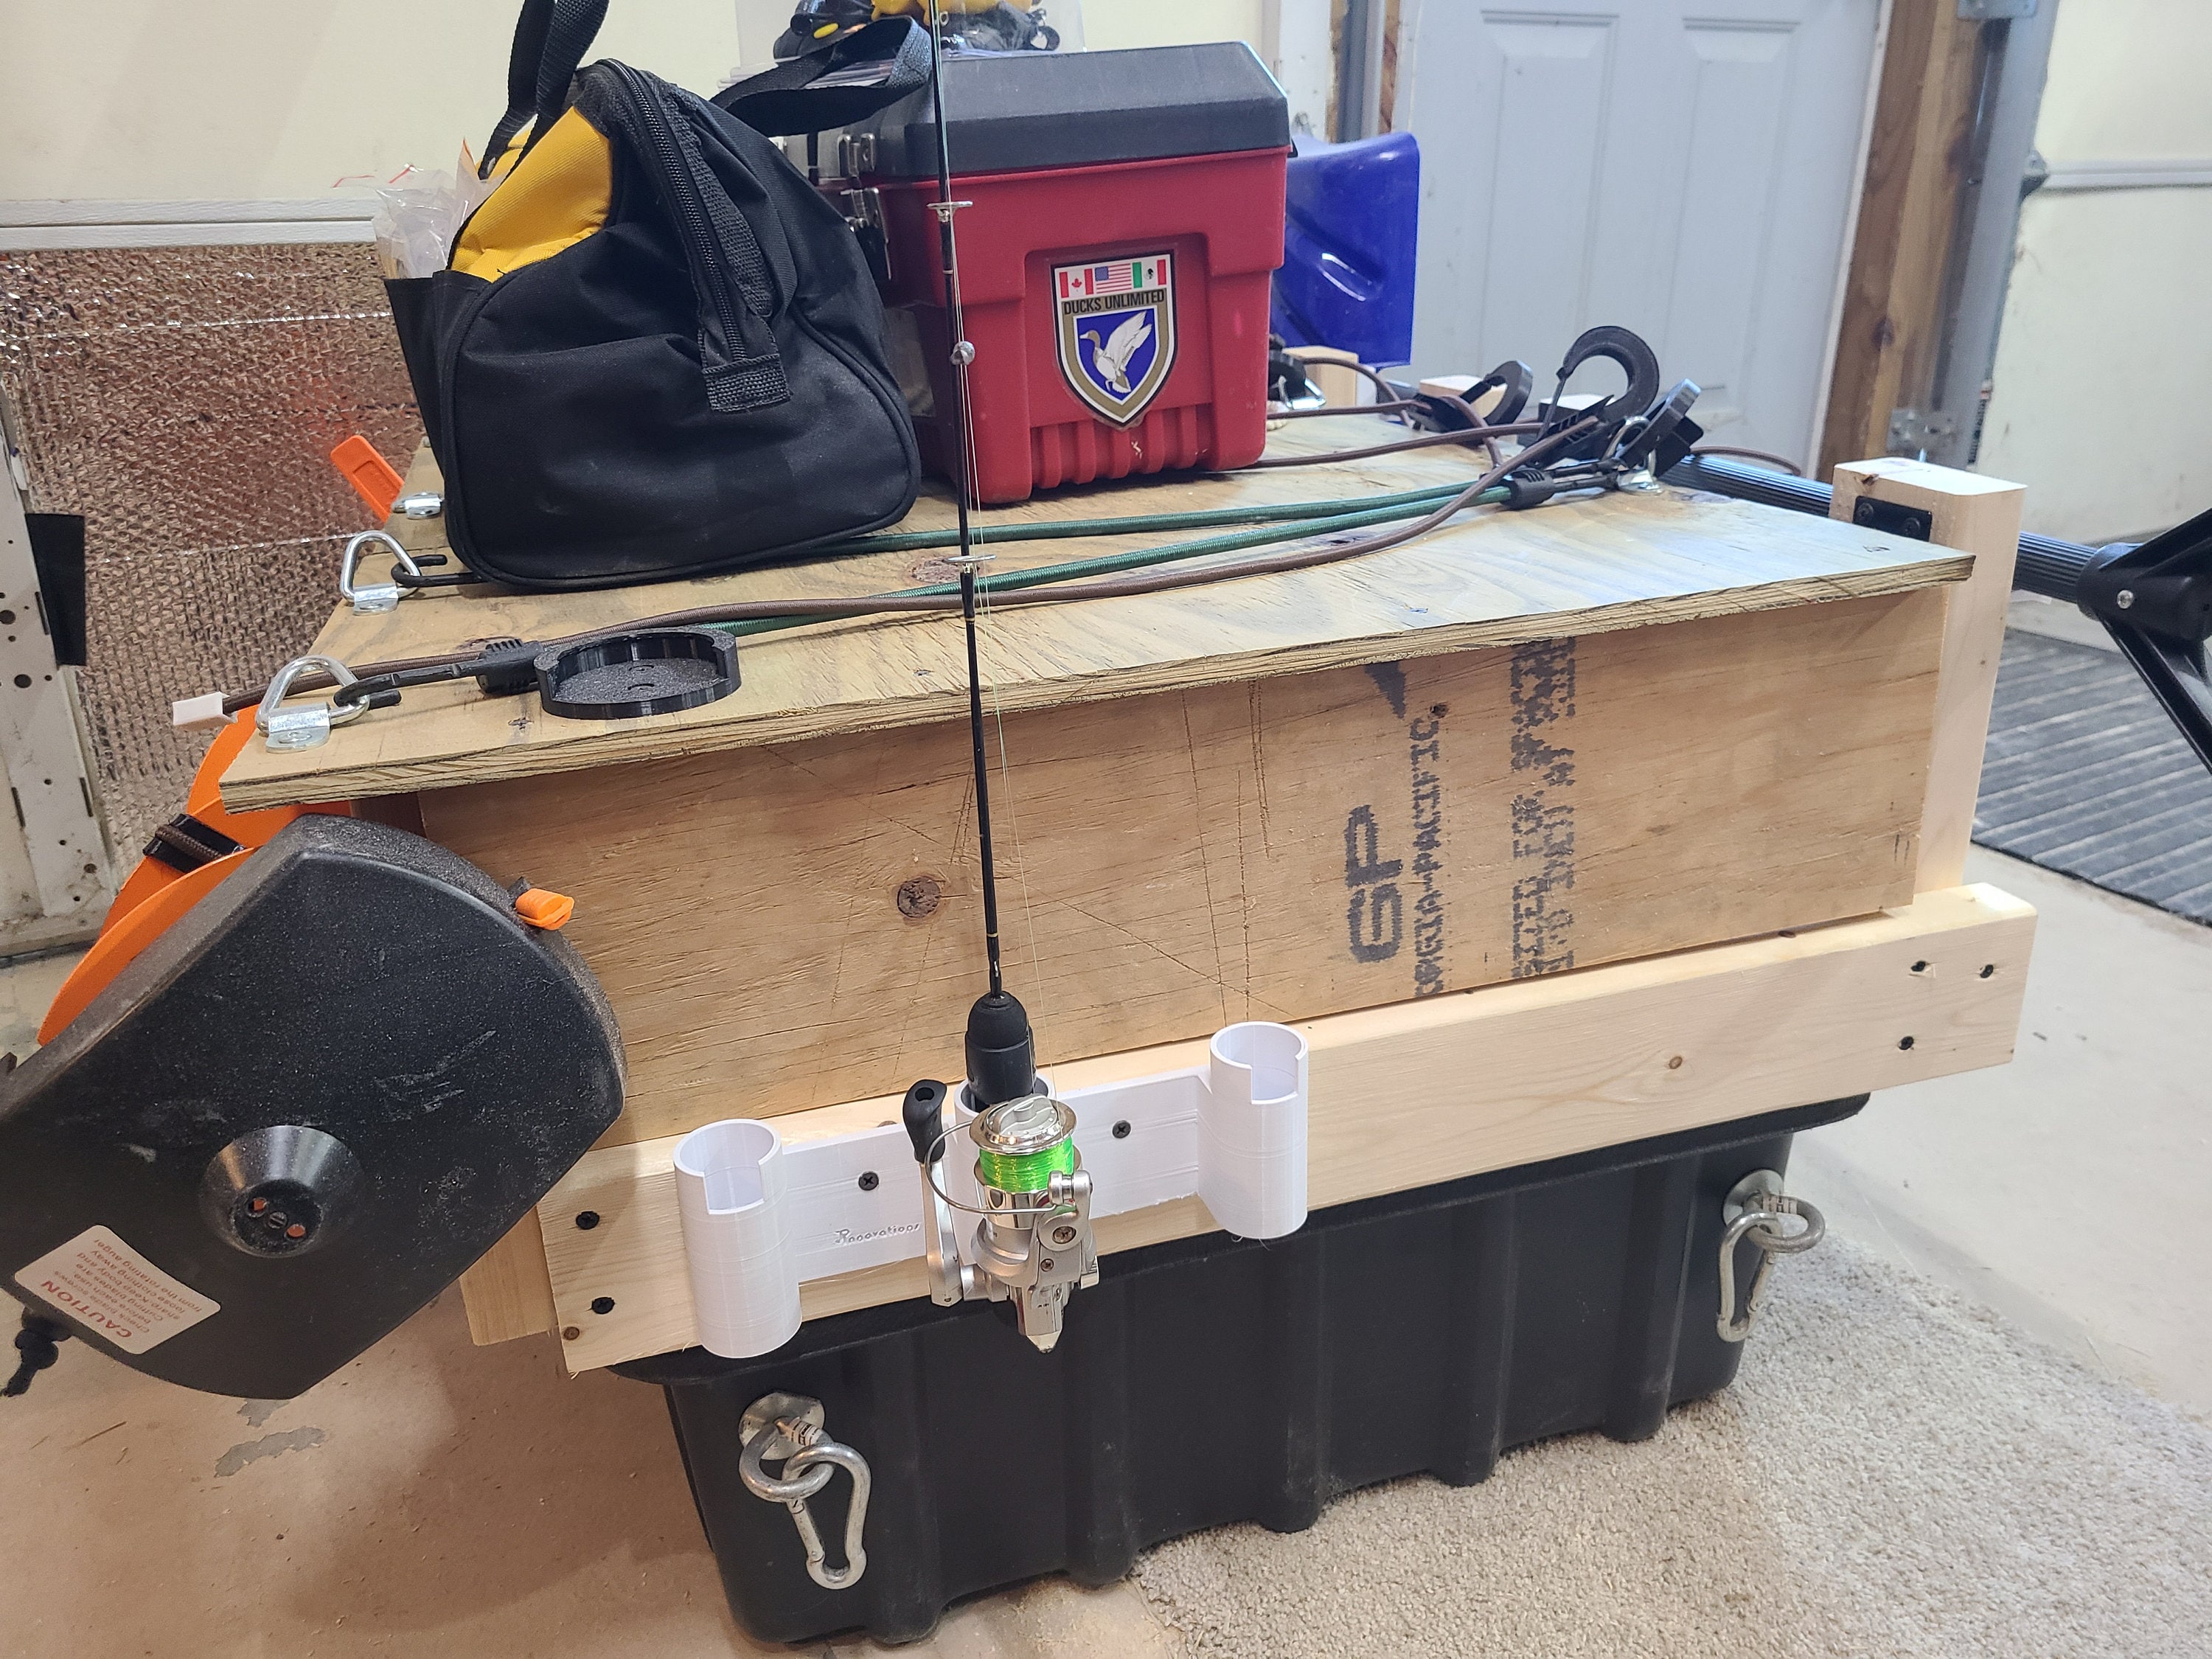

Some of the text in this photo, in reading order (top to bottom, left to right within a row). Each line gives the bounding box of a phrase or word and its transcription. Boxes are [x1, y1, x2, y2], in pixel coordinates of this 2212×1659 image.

[1064, 291, 1165, 315] DUCKS UNLIMITED
[1345, 804, 1402, 963] GP
[75, 1264, 93, 1275] are
[76, 1252, 97, 1266] and
[91, 1251, 117, 1269] away
[94, 1239, 201, 1312] from the rotating auger
[97, 1267, 122, 1286] body
[116, 1269, 156, 1296] clothing
[41, 1280, 131, 1337] CAUTION
